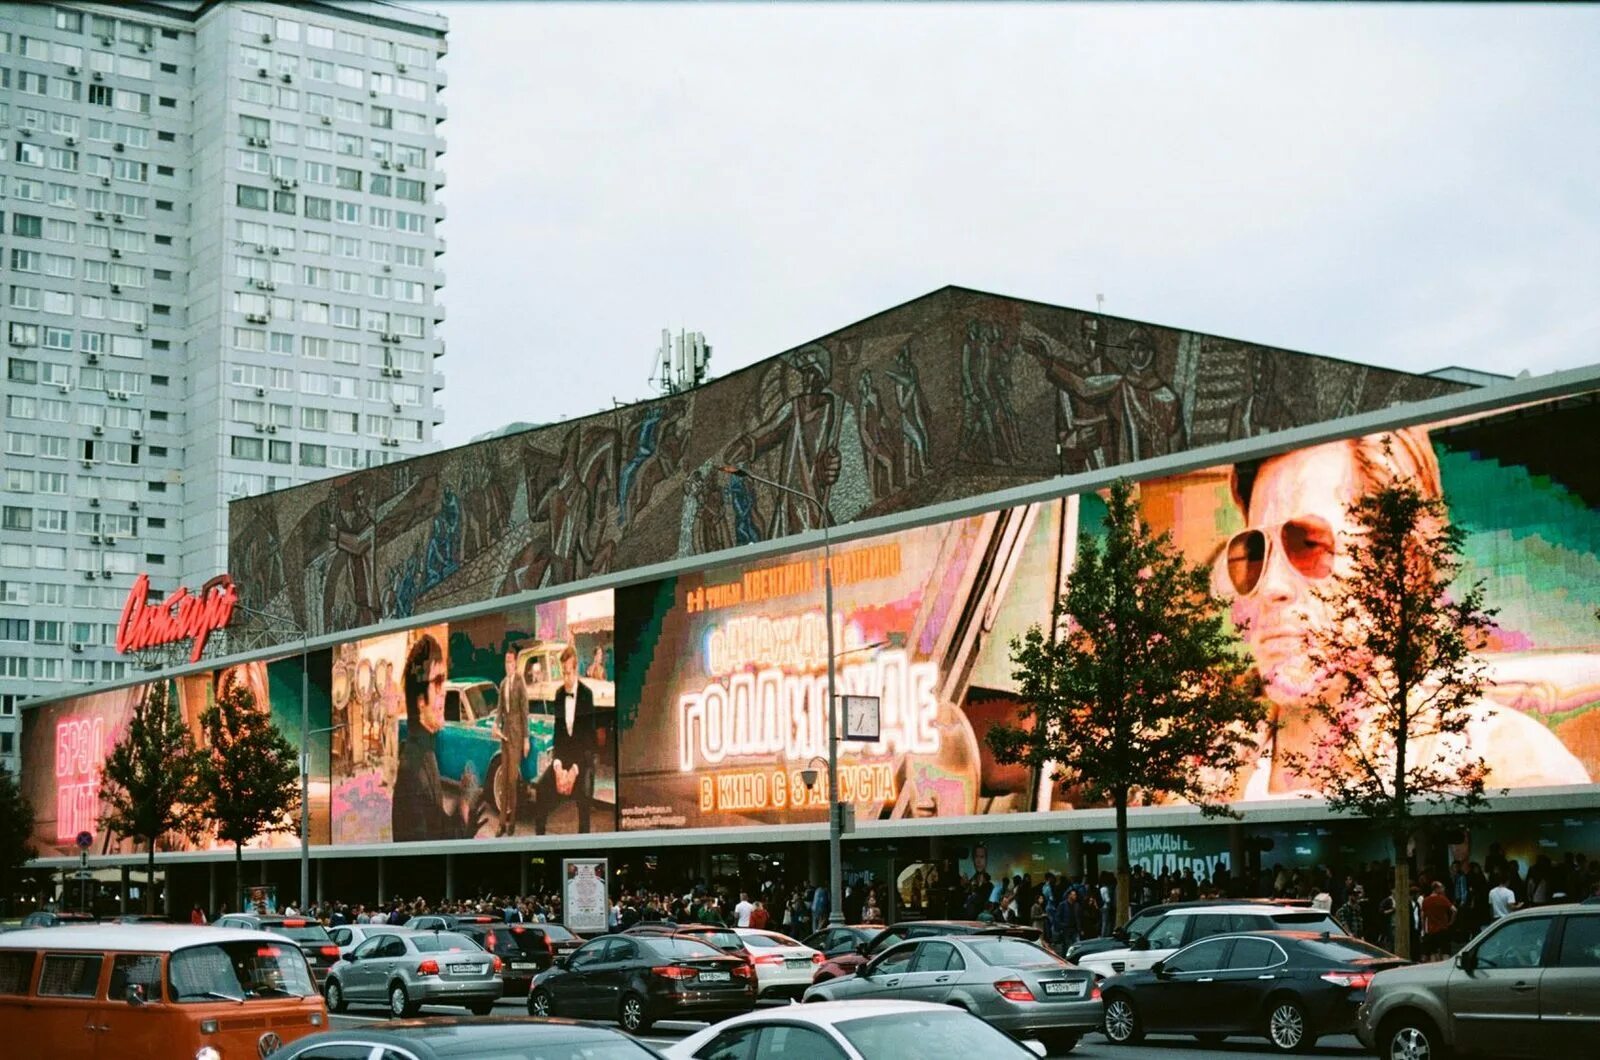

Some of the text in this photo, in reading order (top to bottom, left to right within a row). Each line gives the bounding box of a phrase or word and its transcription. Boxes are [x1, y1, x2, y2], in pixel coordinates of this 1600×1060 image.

[743, 560, 814, 601] КВЕНТИНА
[56, 716, 104, 778] БРЭД
[701, 777, 714, 811] В
[718, 773, 767, 810] КИНО
[771, 771, 786, 807] С
[791, 769, 806, 805] 8
[1127, 834, 1181, 857] ДНАЖДЫ
